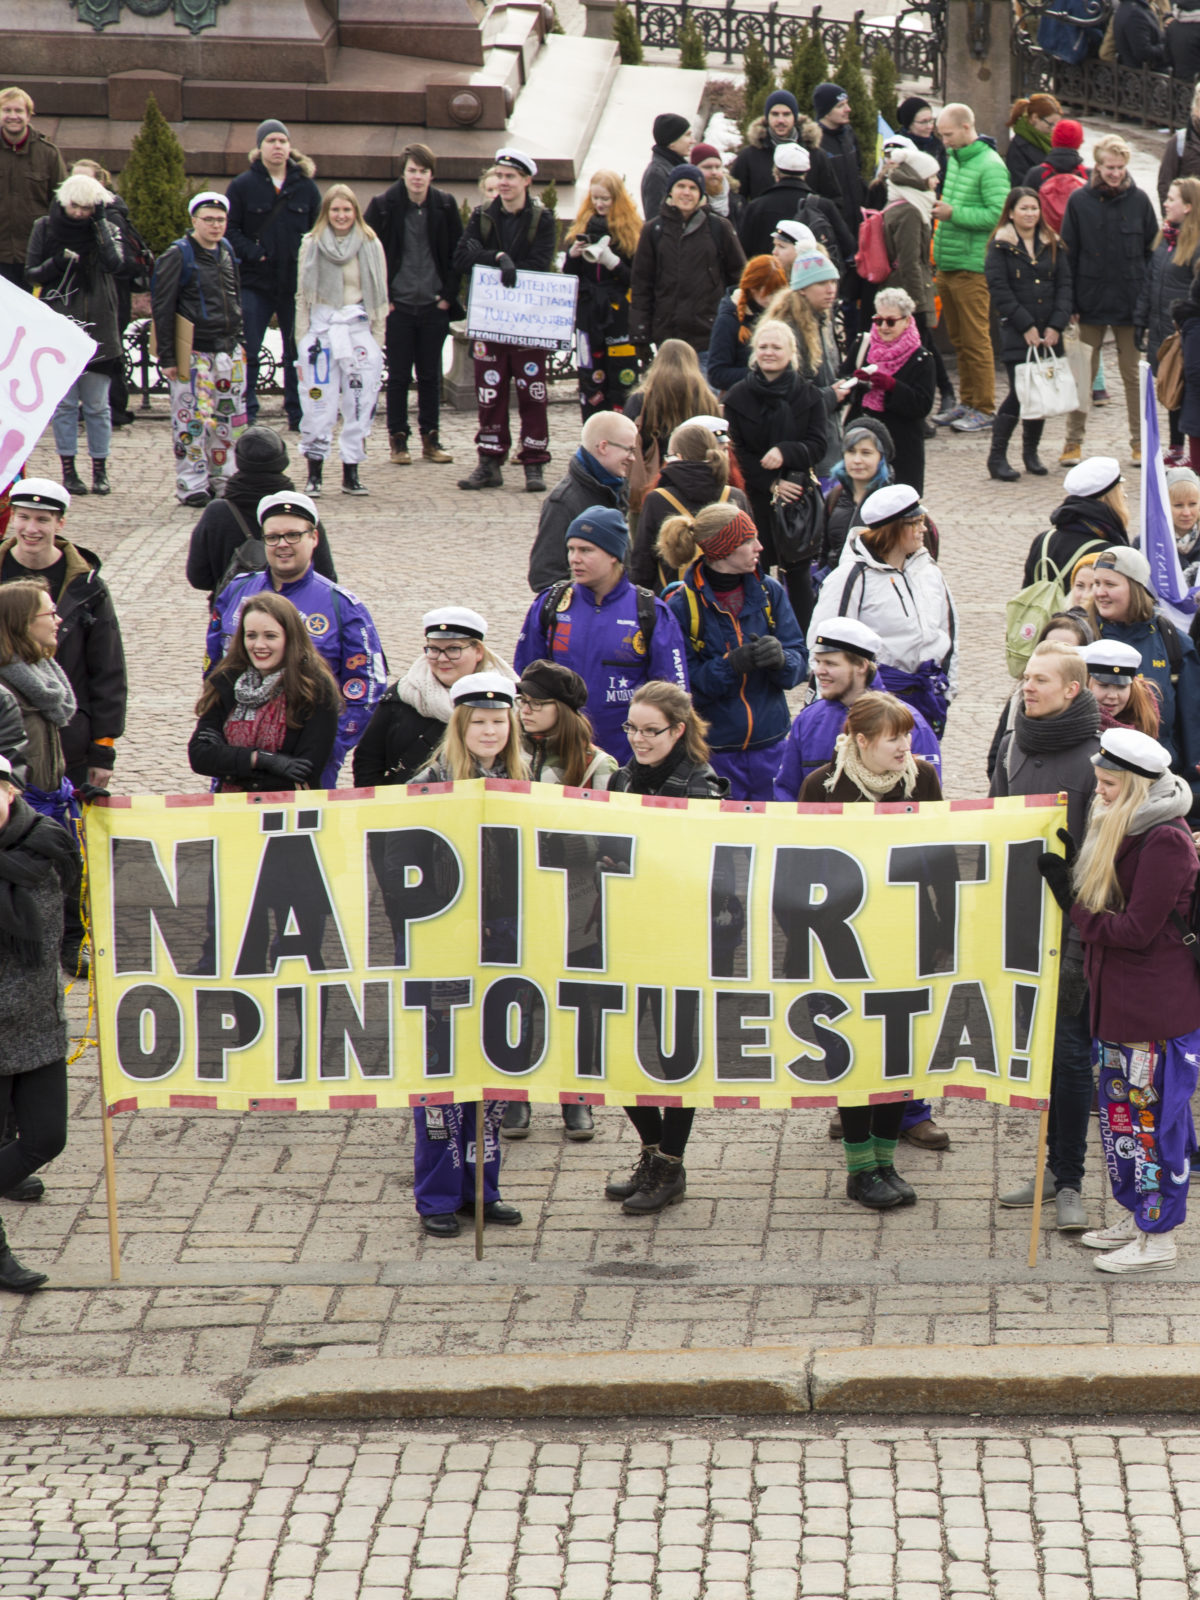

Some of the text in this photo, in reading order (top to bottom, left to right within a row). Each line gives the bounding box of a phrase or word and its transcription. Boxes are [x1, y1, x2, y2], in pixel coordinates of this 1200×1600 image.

[468, 330, 558, 349] #KOULUTUSLUPAUS
[109, 807, 1047, 983] NÄPIT IRTI
[115, 975, 1039, 1084] OPINTOTUESTA!
